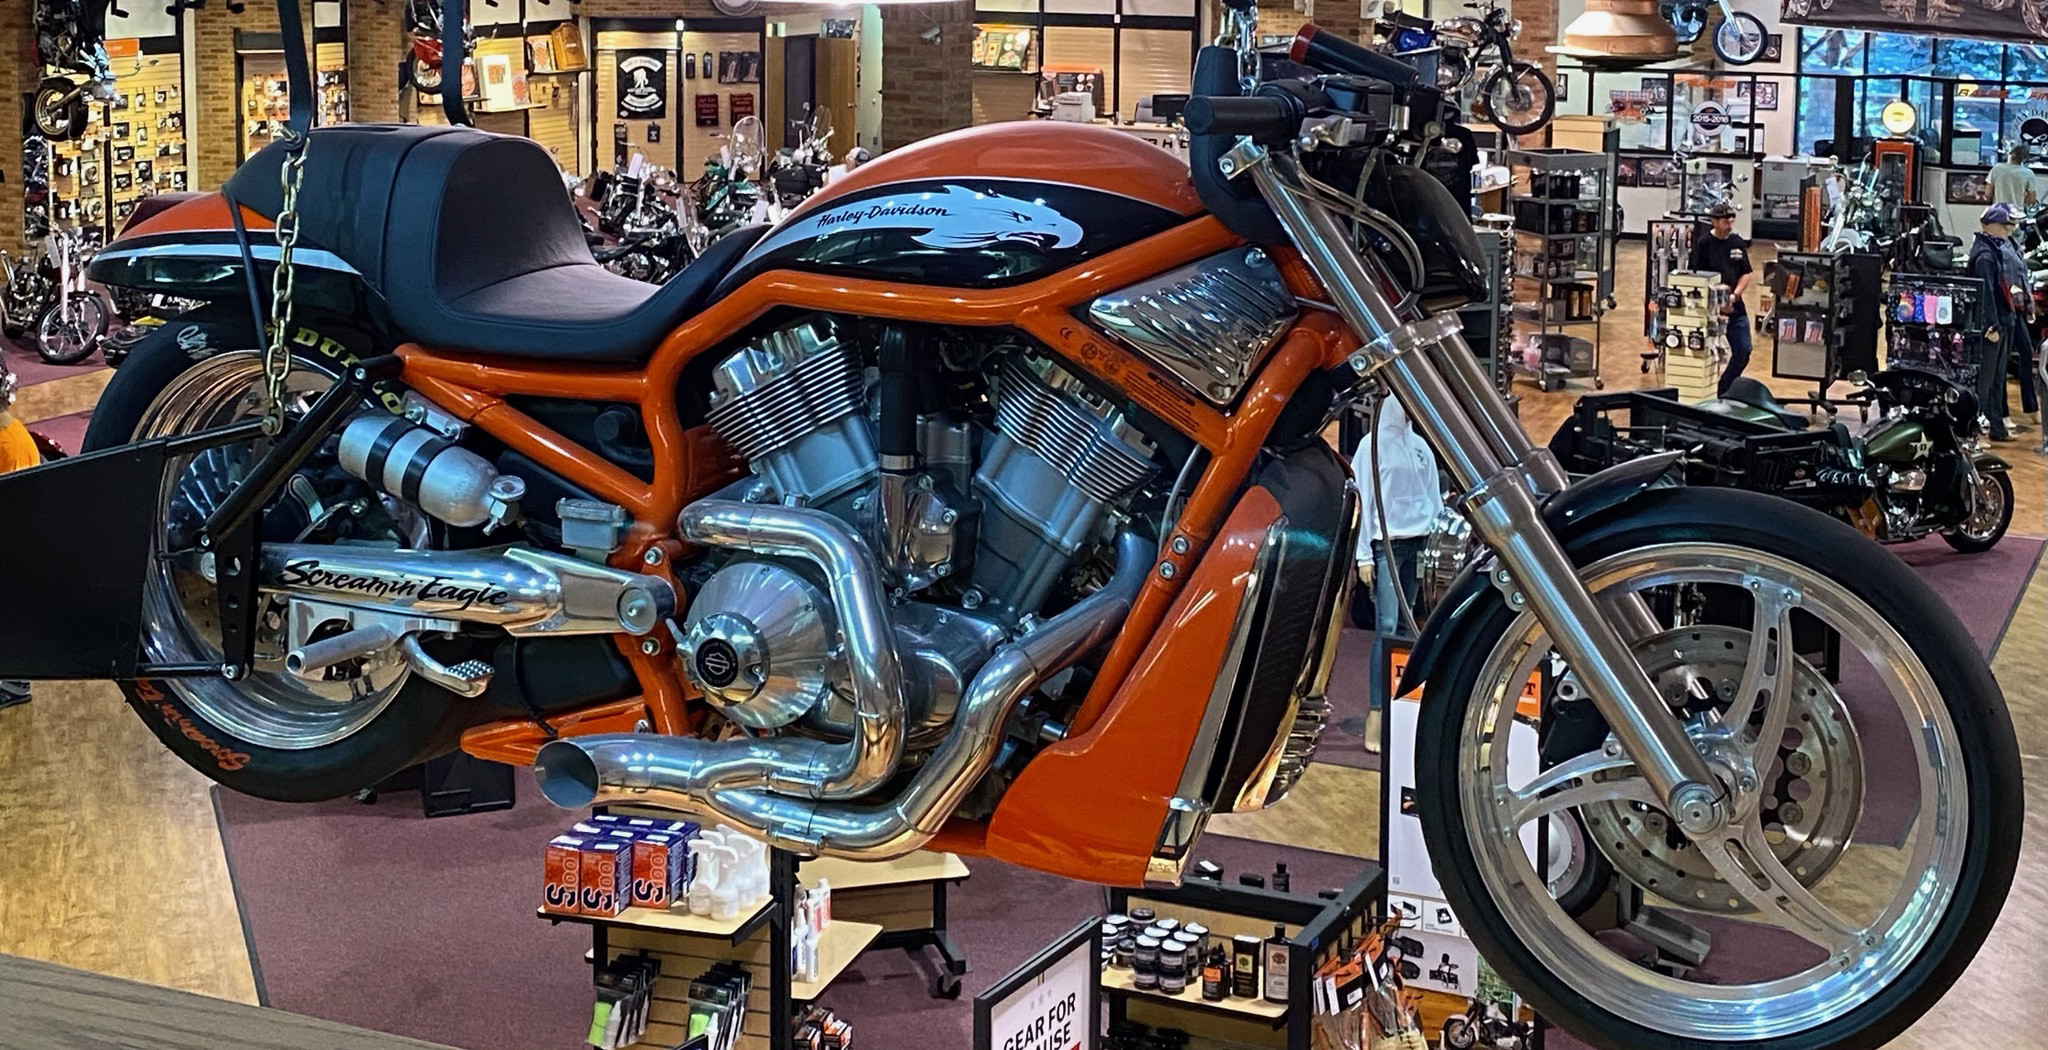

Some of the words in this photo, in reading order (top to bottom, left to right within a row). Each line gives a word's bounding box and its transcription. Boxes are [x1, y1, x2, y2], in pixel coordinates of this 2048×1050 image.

[817, 203, 957, 228] Harley-Davidson
[416, 576, 509, 611] Eagle
[1003, 1015, 1045, 1050] GEAR
[1048, 992, 1076, 1031] FOR
